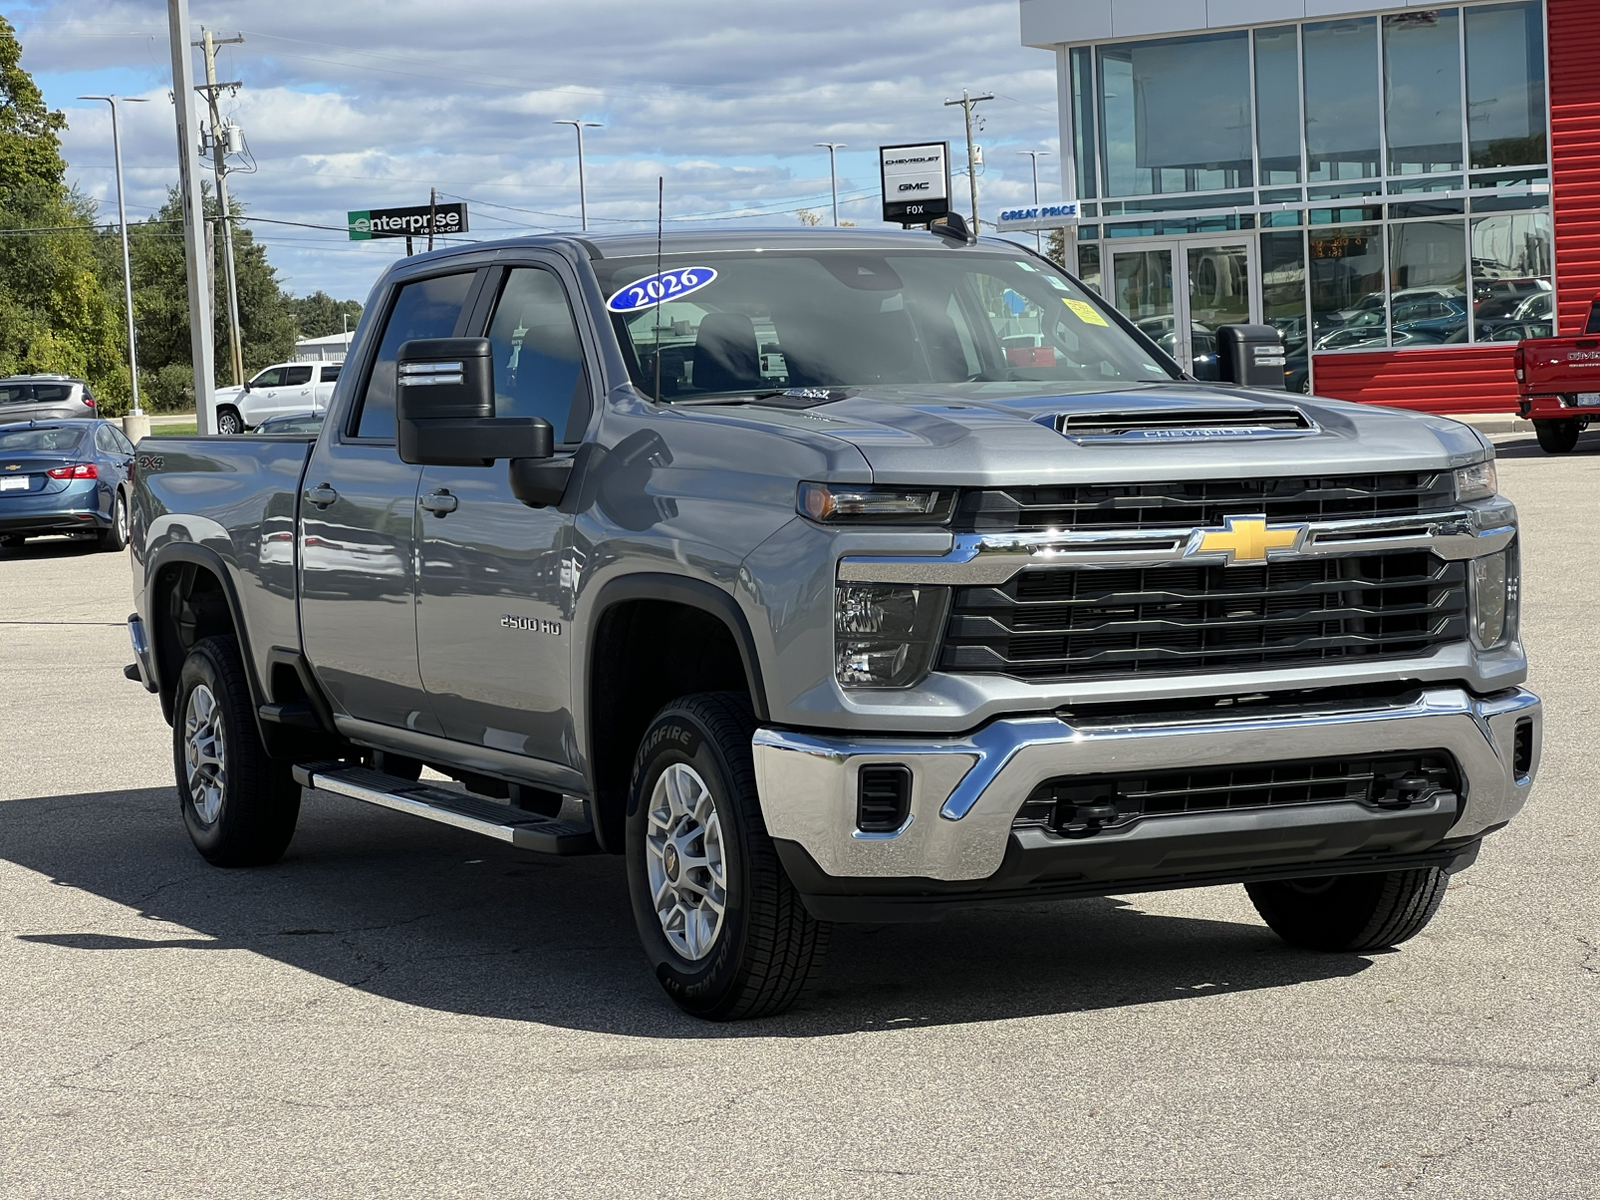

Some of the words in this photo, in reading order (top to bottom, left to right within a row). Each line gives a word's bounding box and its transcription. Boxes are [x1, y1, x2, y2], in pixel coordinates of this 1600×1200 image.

[885, 156, 940, 165] CHEVROLET
[898, 182, 930, 193] GMC
[906, 204, 924, 214] FOX
[1001, 208, 1038, 222] GREAT
[1042, 204, 1076, 217] PRICE
[420, 225, 460, 234] ret-a-car
[629, 269, 698, 307] 2026
[1143, 428, 1254, 438] CHEVROLET
[500, 613, 539, 632] 2500
[541, 620, 562, 636] HD
